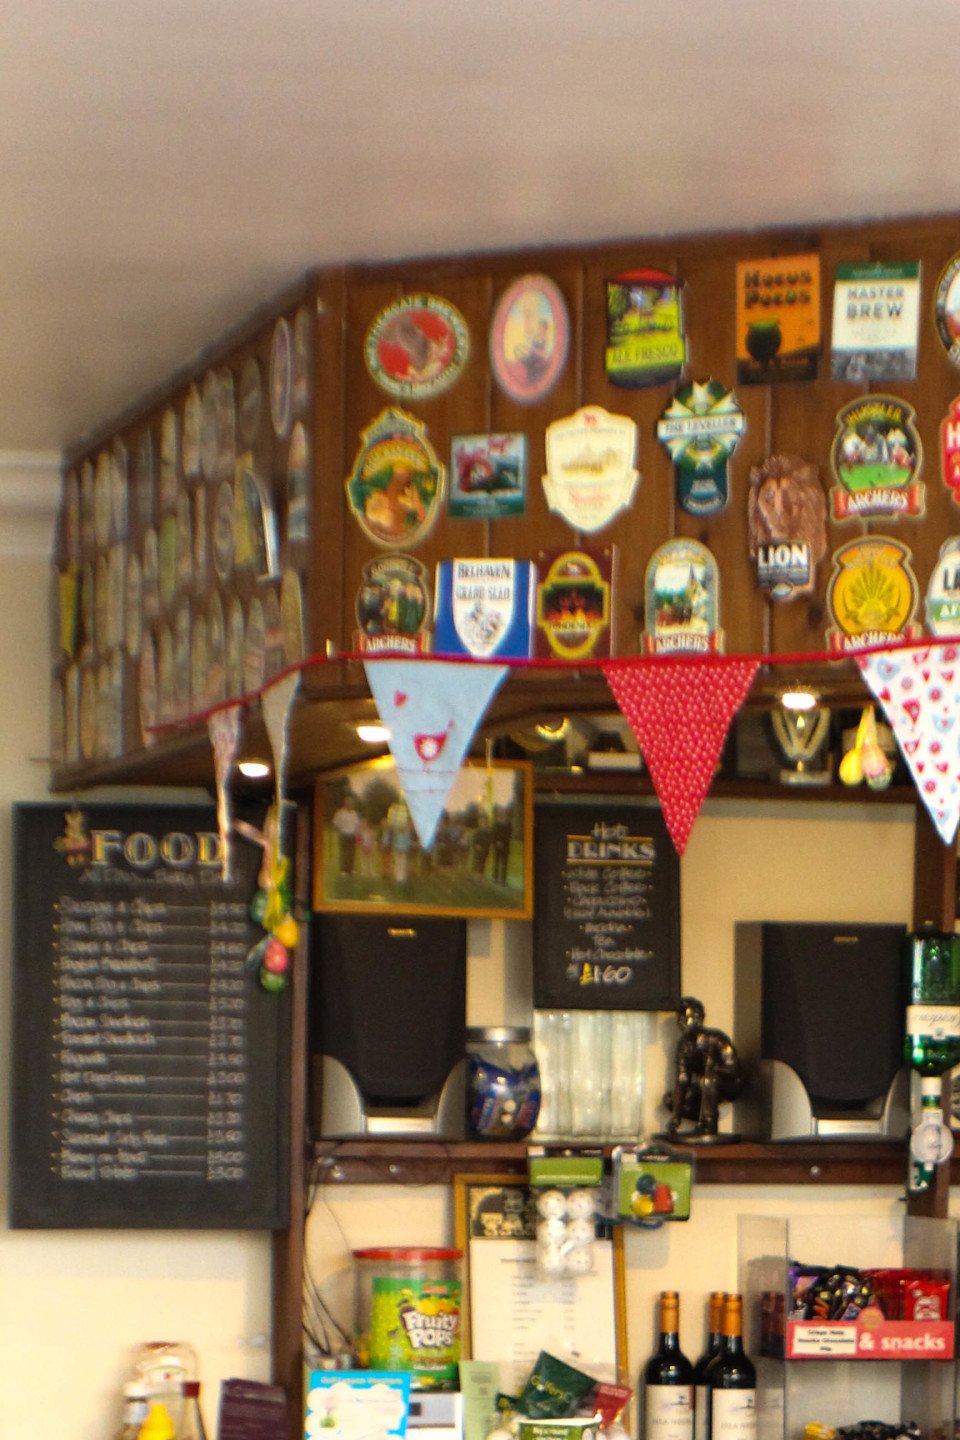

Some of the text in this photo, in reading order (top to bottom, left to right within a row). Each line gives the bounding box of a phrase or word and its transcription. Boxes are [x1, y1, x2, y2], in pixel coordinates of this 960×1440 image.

[847, 286, 905, 298] MASTER
[847, 302, 904, 319] BREW
[758, 544, 808, 566] LION
[90, 829, 226, 867] FOOD
[567, 841, 656, 860] DRINKS
[402, 1310, 459, 1332] Fruity
[407, 1328, 455, 1349] POPS
[858, 1331, 946, 1351] & snacks
